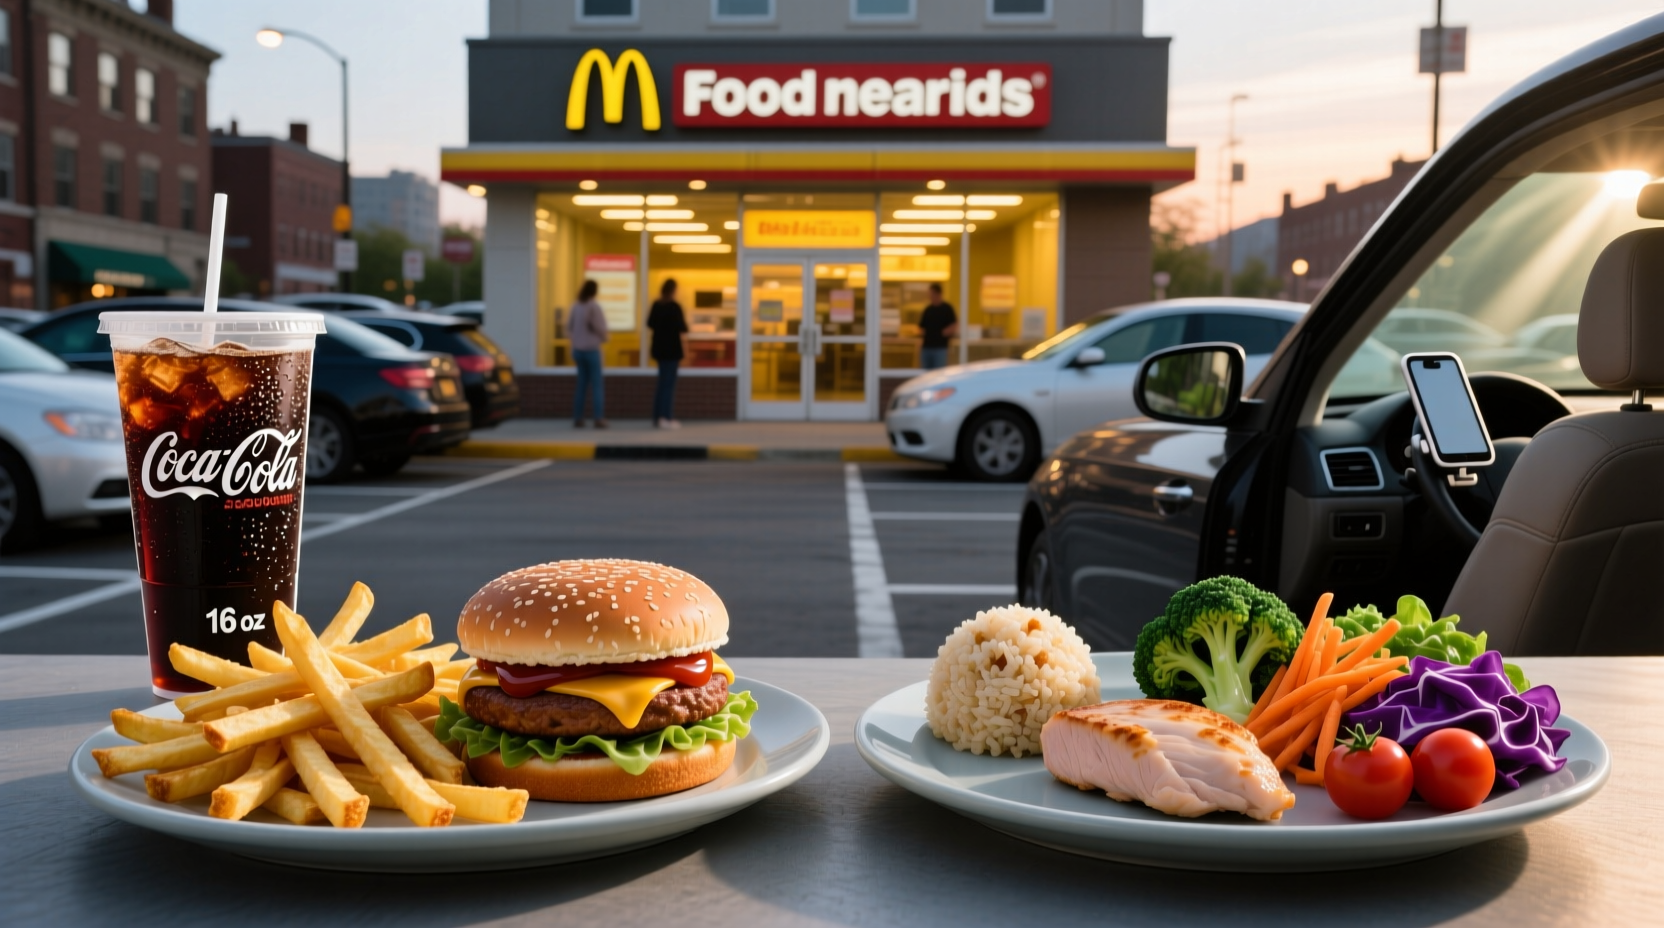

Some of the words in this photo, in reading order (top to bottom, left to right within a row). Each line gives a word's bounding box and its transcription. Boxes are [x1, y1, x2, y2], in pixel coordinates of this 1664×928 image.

[683, 69, 817, 117] Food
[823, 68, 1035, 118] nearids
[141, 428, 302, 500] Coca-Cola
[206, 607, 237, 634] 16
[240, 613, 265, 632] oz
